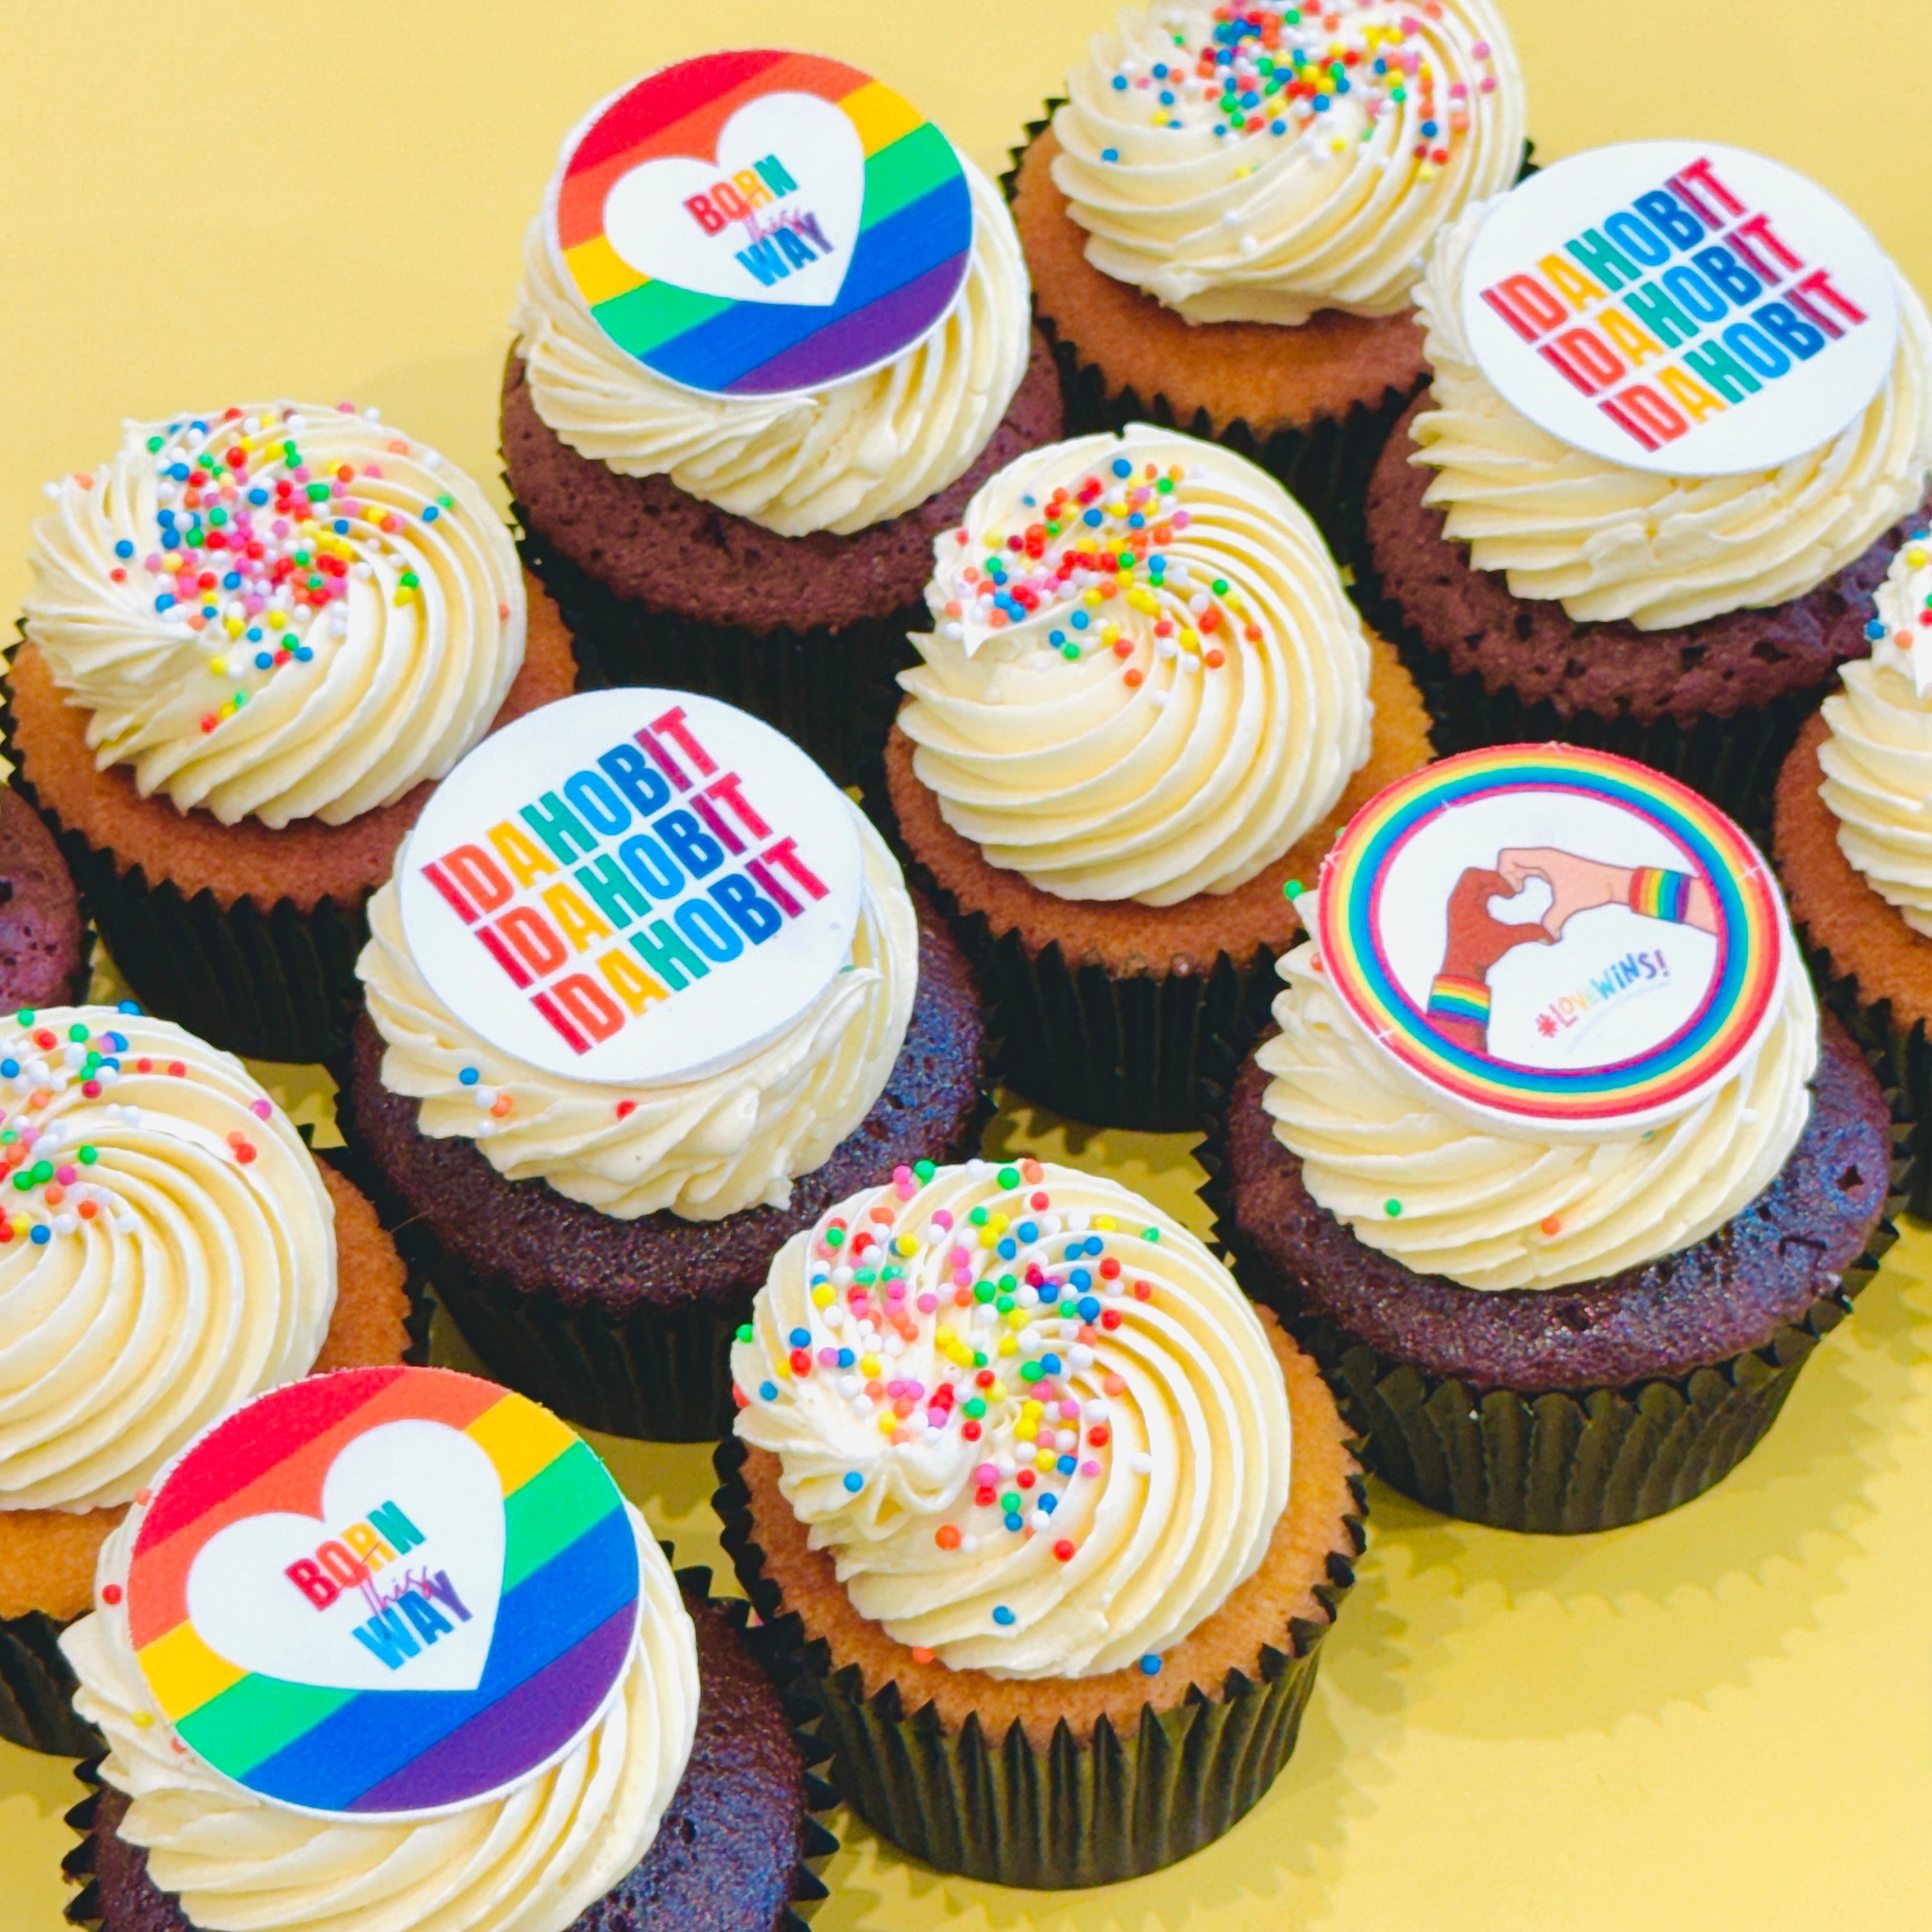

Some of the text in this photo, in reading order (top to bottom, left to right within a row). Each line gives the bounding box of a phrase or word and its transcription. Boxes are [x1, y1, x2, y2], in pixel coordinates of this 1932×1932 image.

[682, 154, 799, 237] BORN
[735, 211, 834, 287] WAY
[1480, 156, 1747, 345] IDAHOBIT
[1537, 213, 1805, 398] IDAHOBIT
[1597, 268, 1867, 453] IDAHOBIT
[420, 705, 720, 926] IDAHOBIT
[474, 771, 774, 990] IDAHOBIT
[529, 836, 831, 1057] IDAHOBIT
[284, 1500, 427, 1613] BORN
[352, 1568, 473, 1670] WAY
